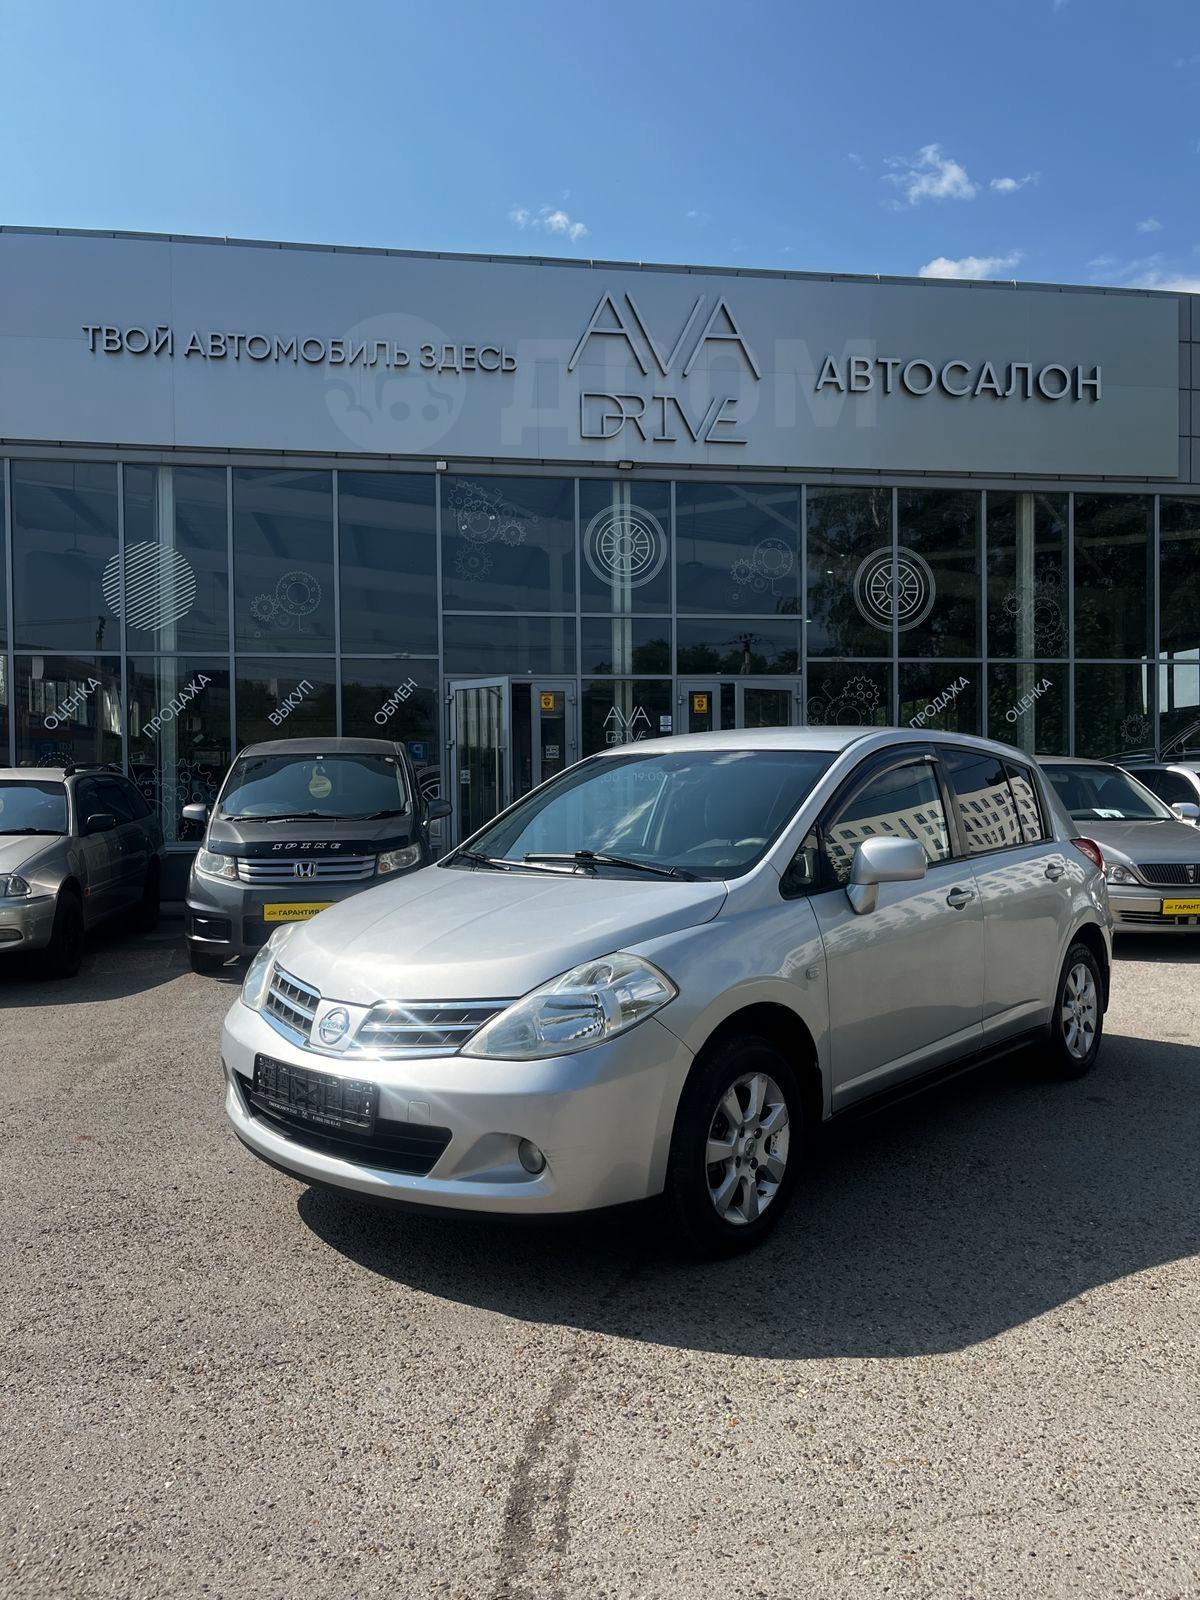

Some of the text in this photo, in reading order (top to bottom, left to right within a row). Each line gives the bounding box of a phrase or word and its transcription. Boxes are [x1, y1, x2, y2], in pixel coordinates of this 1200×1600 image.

[82, 324, 518, 374] ТВОЙ АВТОМОБИЛЬ ЗДЕСЬ
[568, 290, 762, 380] AVA
[816, 355, 1102, 403] АВТОСАЛОН
[580, 391, 748, 444] DRIVE
[44, 676, 102, 730] ОЦЕНКА
[142, 673, 211, 739] ПРОДАЖА
[267, 679, 314, 727] ВЫКУП
[374, 677, 419, 726] ОБМЕН
[603, 706, 651, 727] AVA
[909, 675, 971, 728] ПРОДАЖА
[1005, 677, 1053, 723] ОЦЕНКА
